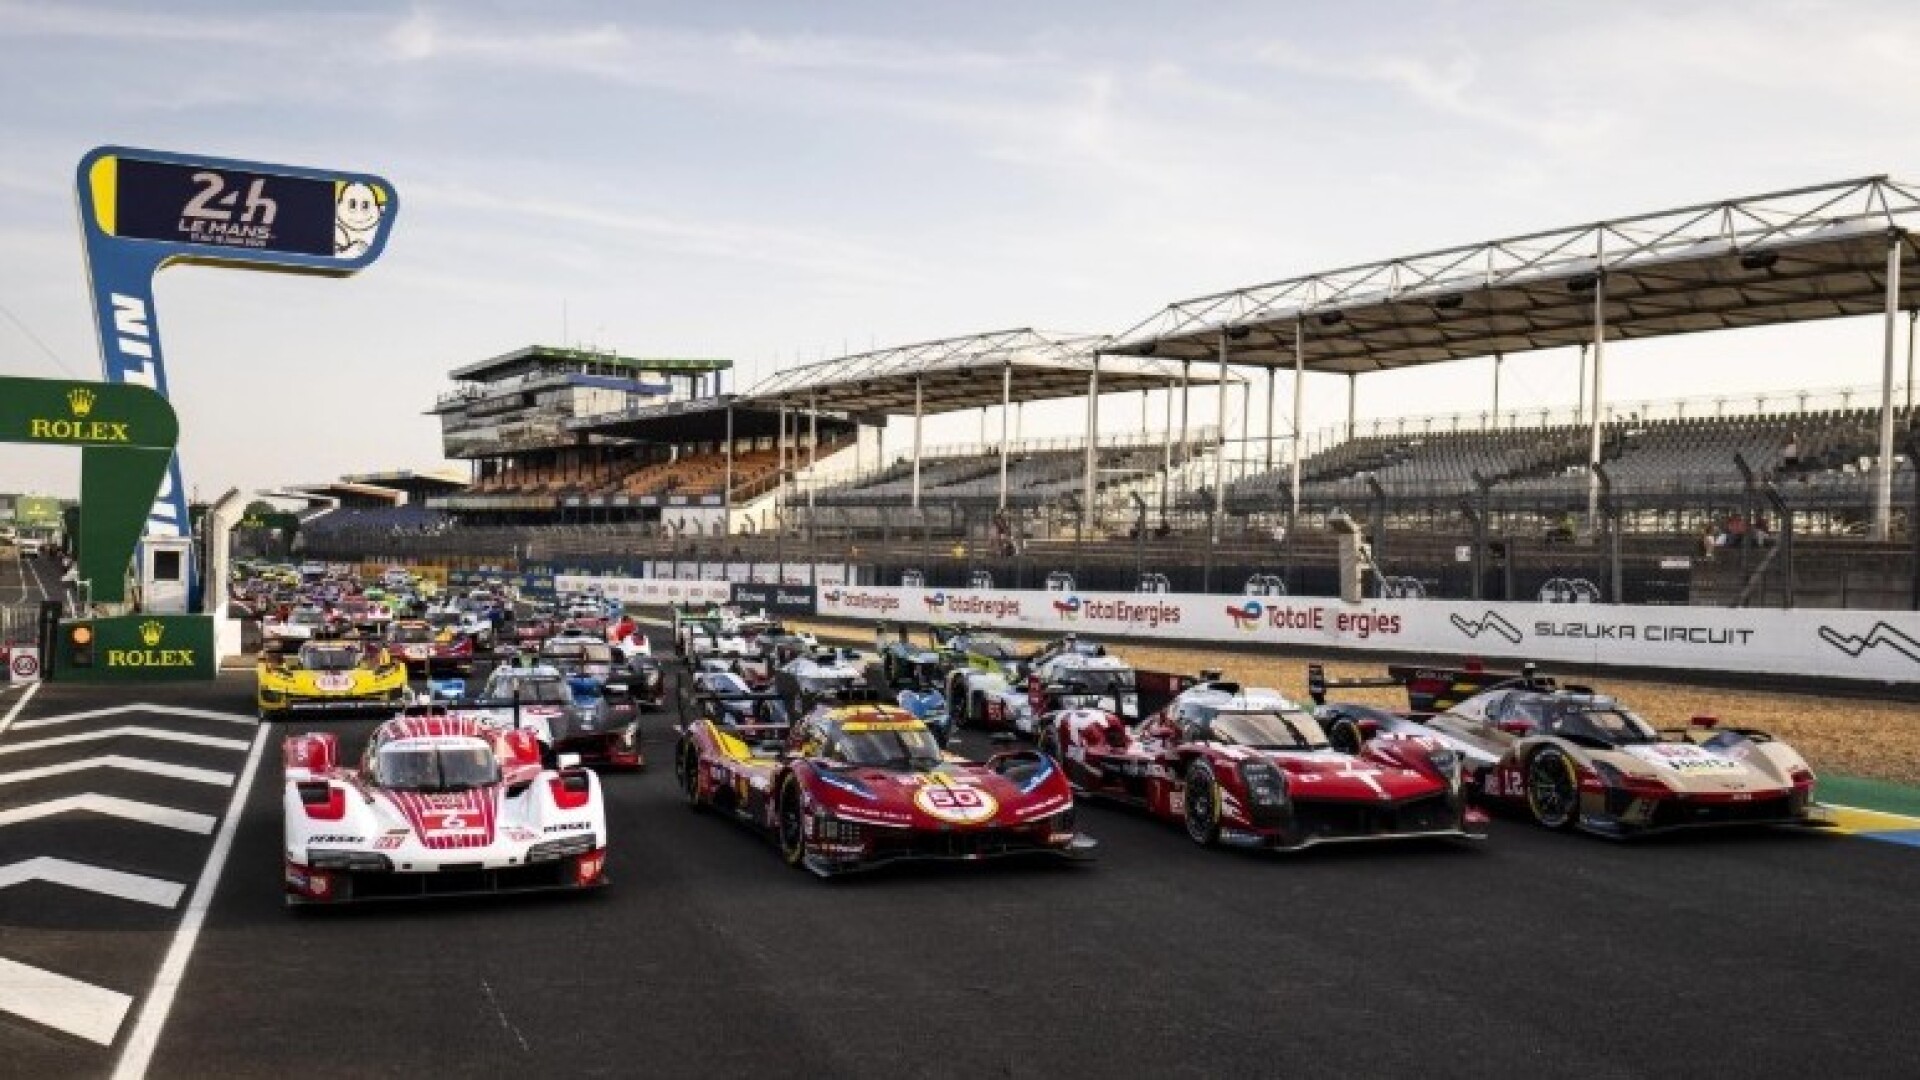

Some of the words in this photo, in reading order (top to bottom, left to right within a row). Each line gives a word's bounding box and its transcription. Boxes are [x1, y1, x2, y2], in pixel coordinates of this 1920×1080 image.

[179, 218, 205, 232] LE
[208, 221, 270, 239] MANS
[31, 418, 130, 441] ROLEX
[841, 591, 900, 613] TotalEnergies
[946, 595, 1020, 619] TotalEnergies
[1083, 600, 1181, 628] TotalEnergies
[1266, 605, 1402, 638] TotalEergies
[1534, 621, 1636, 640] SUZUKA
[1643, 624, 1755, 646] CIRCUIT
[108, 649, 196, 667] ROLEX
